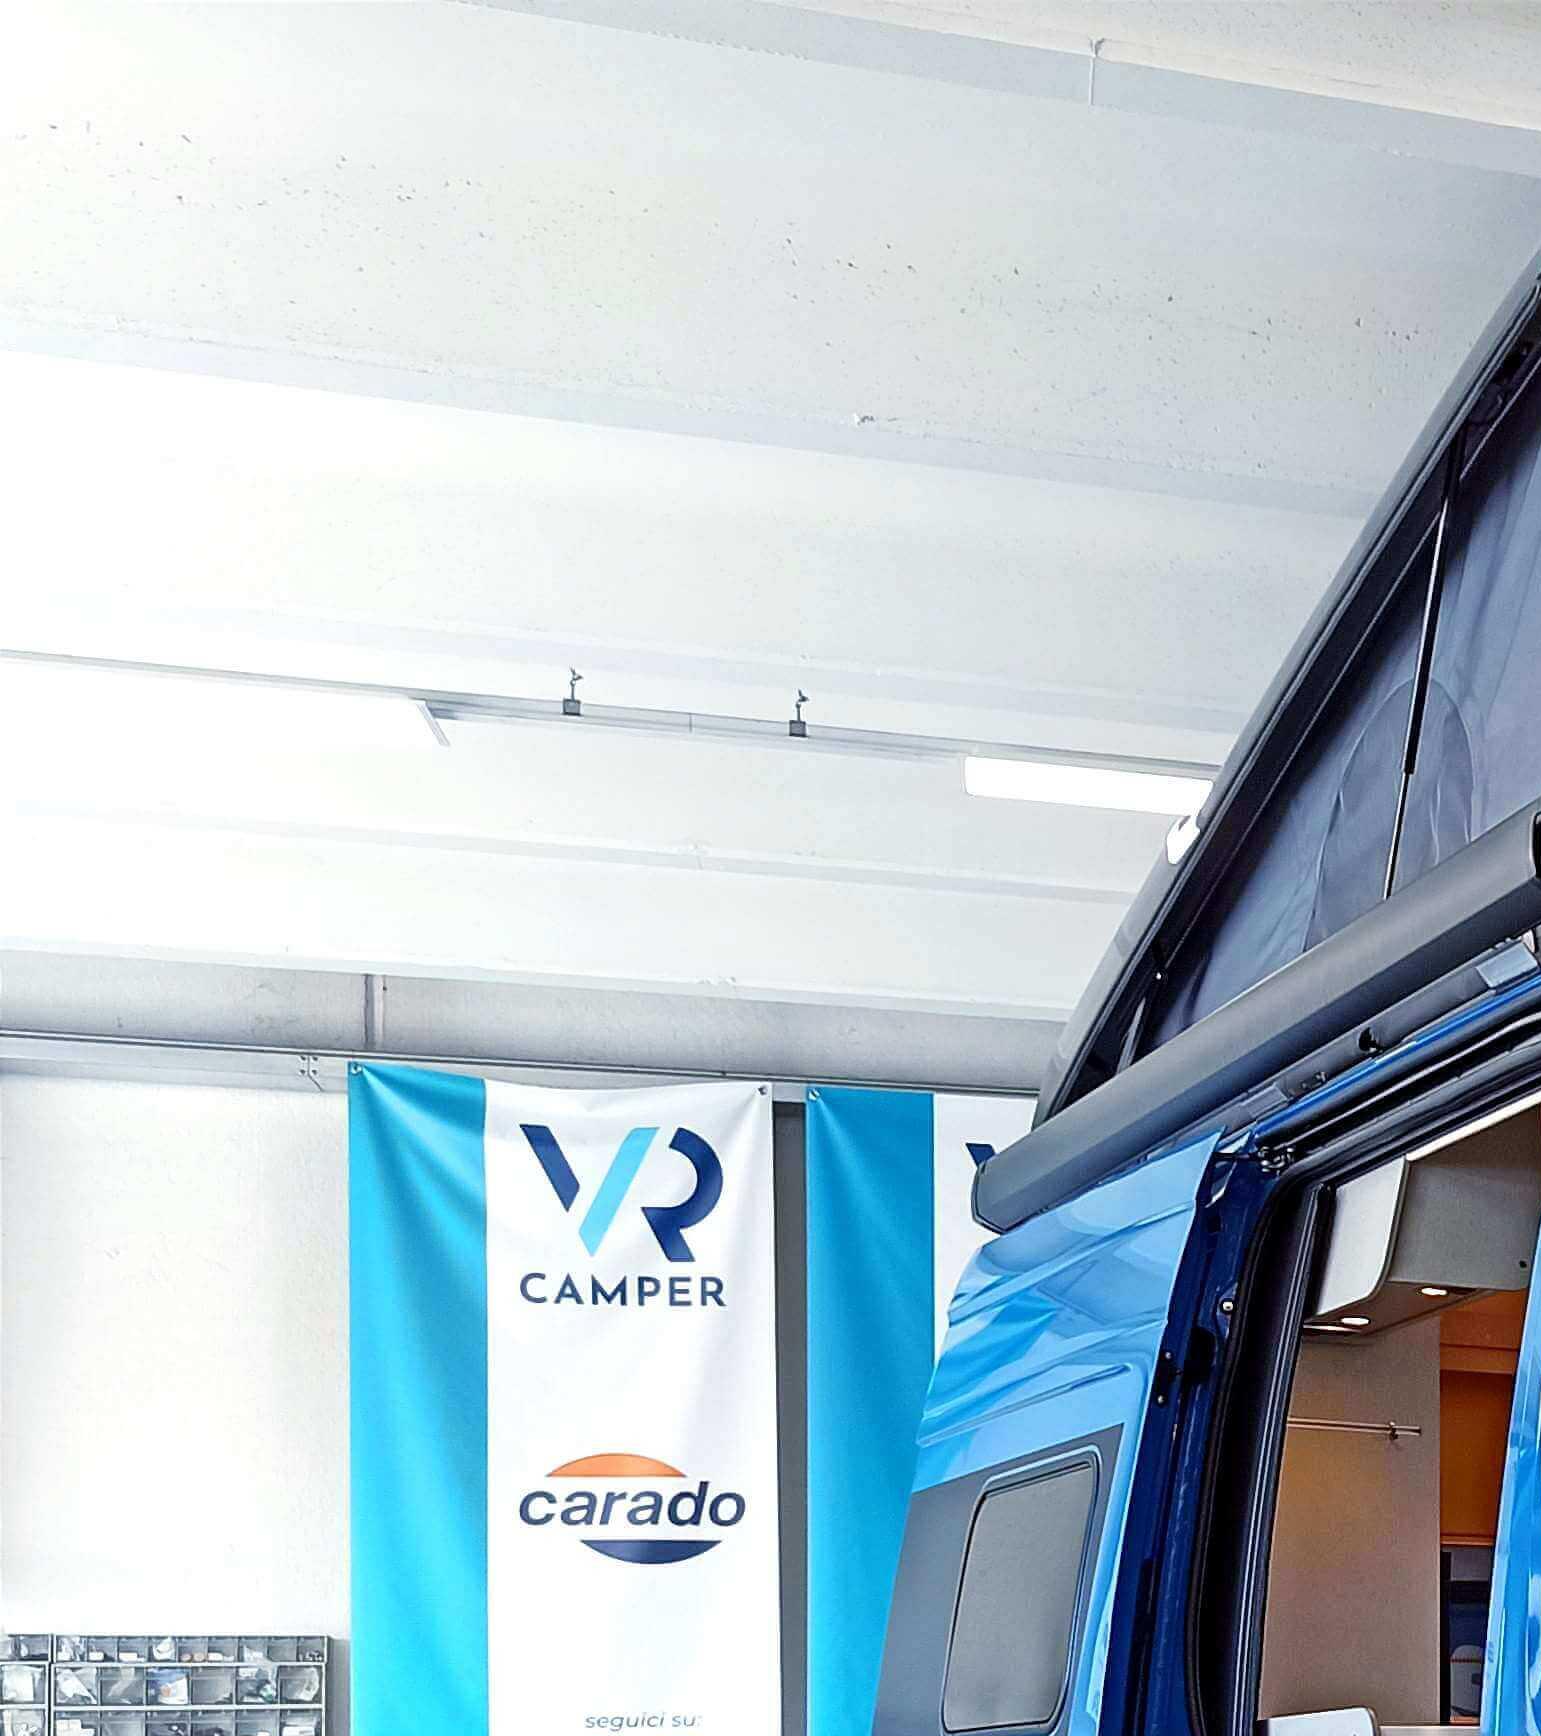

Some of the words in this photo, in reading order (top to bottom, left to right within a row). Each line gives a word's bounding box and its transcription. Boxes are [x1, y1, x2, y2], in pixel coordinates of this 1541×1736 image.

[519, 1124, 723, 1263] VR
[519, 1272, 726, 1308] CAMPER
[519, 1480, 746, 1527] carado
[584, 1713, 666, 1735] seguici
[671, 1714, 702, 1728] su:
